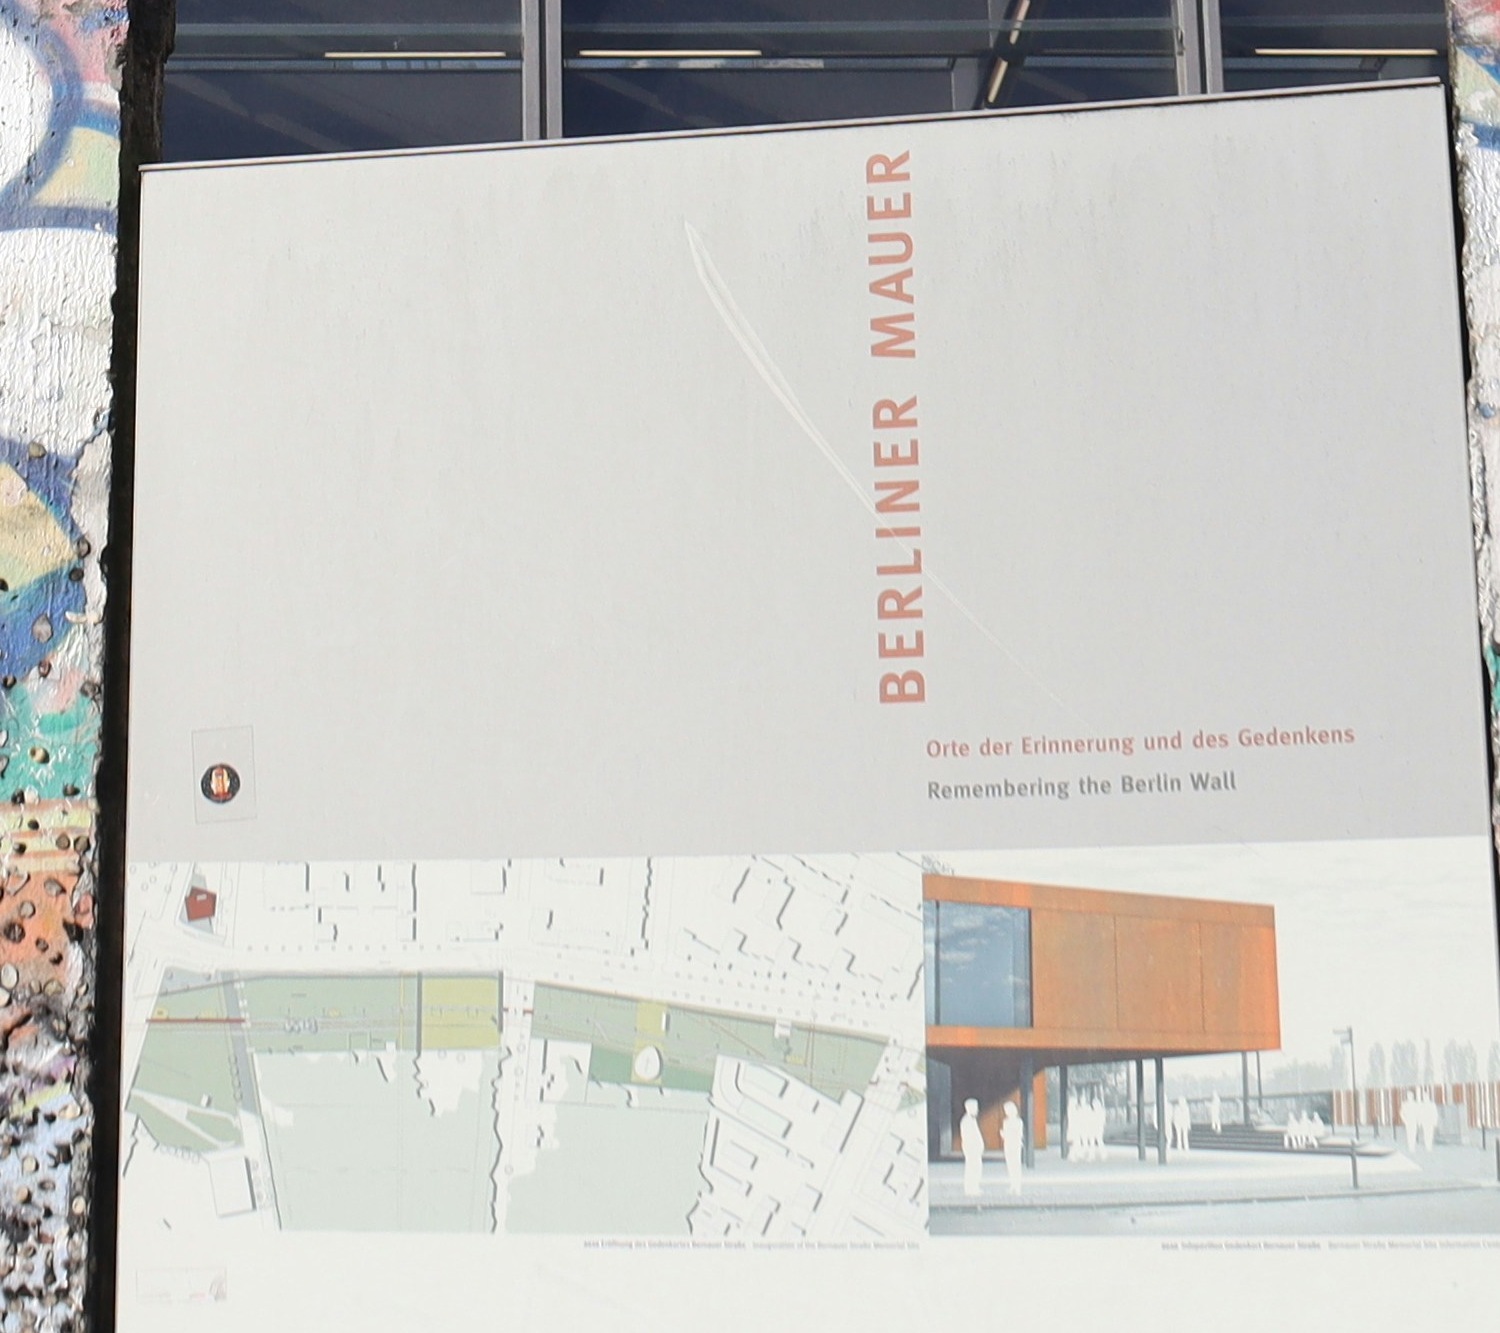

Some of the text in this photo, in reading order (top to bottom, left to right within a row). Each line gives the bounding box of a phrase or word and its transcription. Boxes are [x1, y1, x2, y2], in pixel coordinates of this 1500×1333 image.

[864, 147, 928, 708] BERLINER MAUER
[926, 726, 1355, 758] Orte der Erinnerung und des Gedenkens
[928, 770, 1236, 800] Remembering the Berlin Wall
